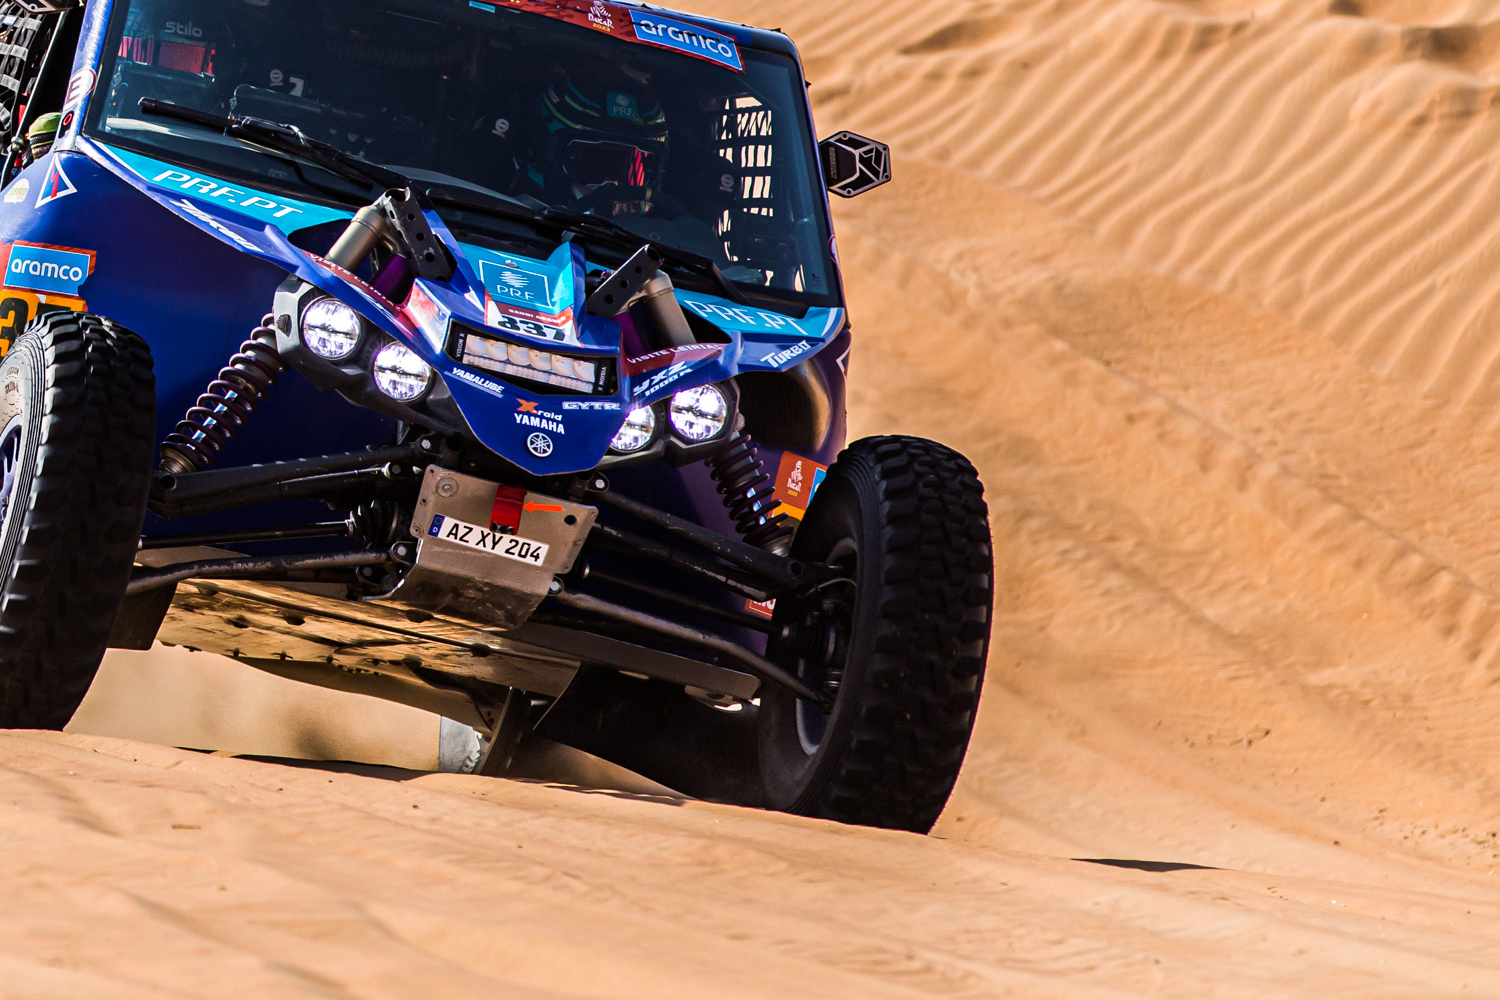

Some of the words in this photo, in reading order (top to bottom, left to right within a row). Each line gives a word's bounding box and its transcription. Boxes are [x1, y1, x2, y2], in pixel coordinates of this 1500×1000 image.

[164, 20, 203, 38] Stilo
[587, 12, 615, 29] DAKAR
[592, 22, 611, 32] 2023
[640, 19, 733, 58] aramco
[152, 169, 304, 218] PRF.PT
[10, 258, 83, 282] aramco
[496, 284, 535, 300] PRF
[684, 300, 809, 336] PRF.PT
[455, 338, 464, 358] VISION
[627, 349, 671, 364] VISITE
[760, 340, 813, 368] TURBO
[452, 367, 505, 393] YAMALUBE
[599, 366, 608, 386] VISION
[632, 361, 688, 396] YXZ
[562, 401, 622, 411] GYTR
[514, 413, 566, 435] YAMAHA
[432, 526, 438, 534] D
[446, 523, 474, 544] AZ
[475, 530, 504, 551] XY
[504, 538, 543, 563] 204
